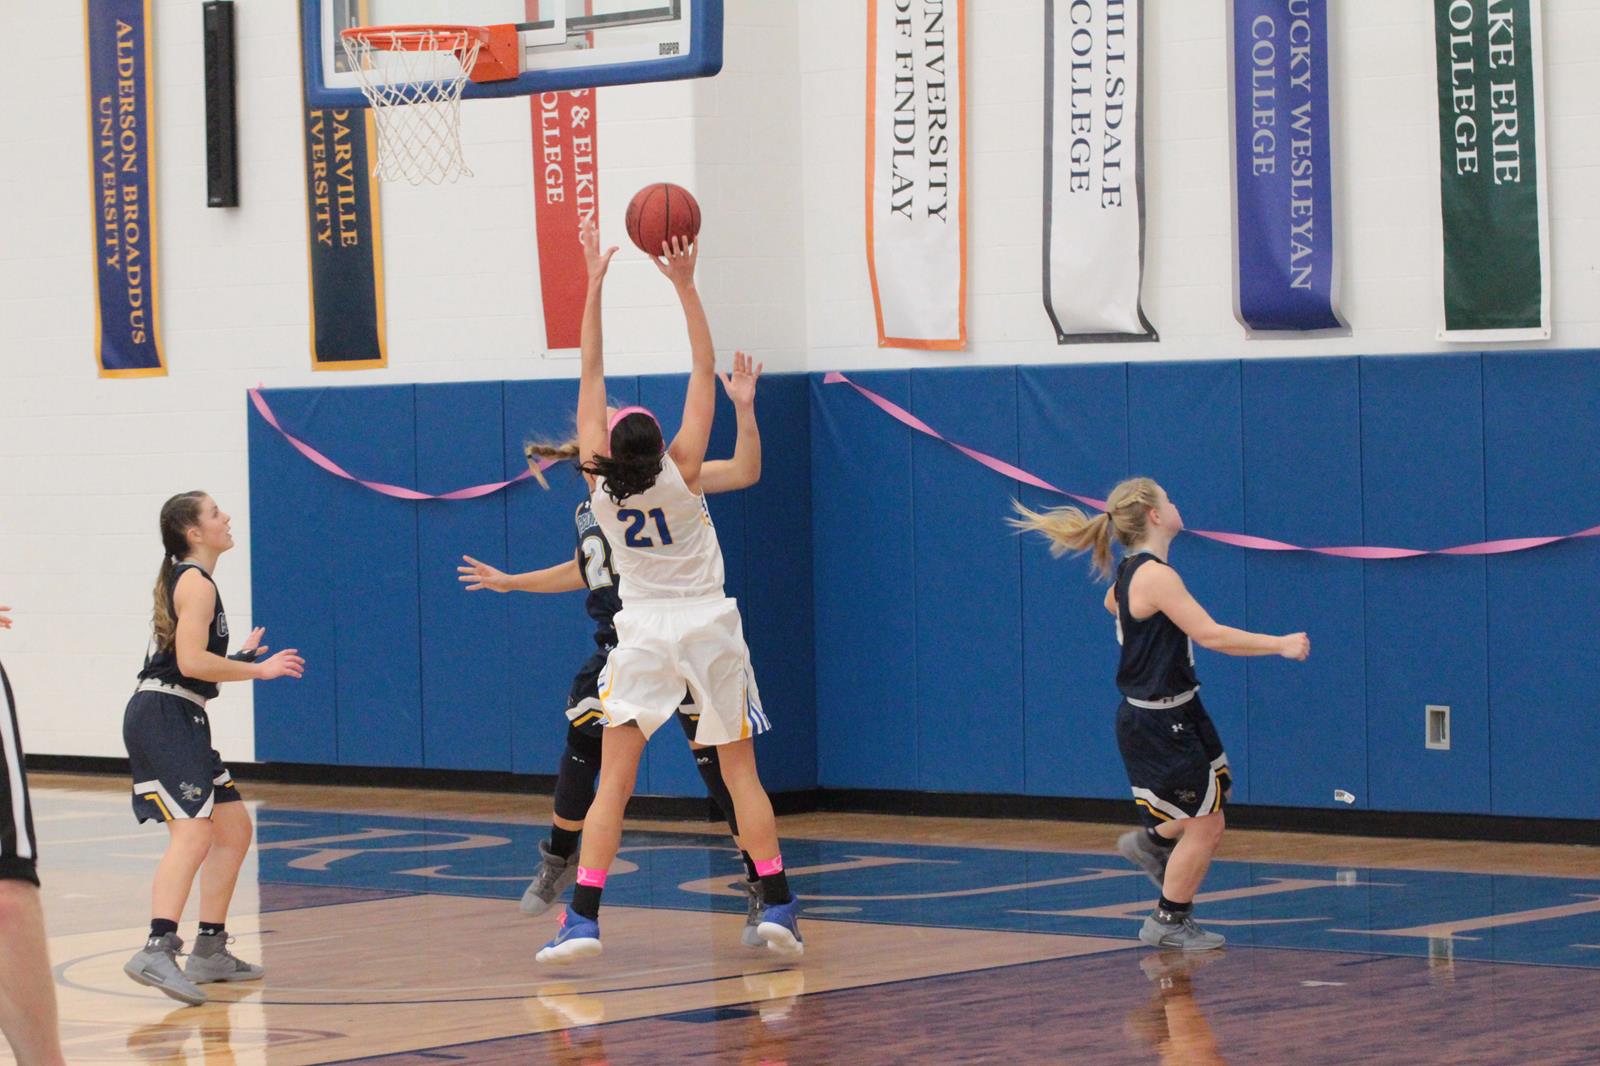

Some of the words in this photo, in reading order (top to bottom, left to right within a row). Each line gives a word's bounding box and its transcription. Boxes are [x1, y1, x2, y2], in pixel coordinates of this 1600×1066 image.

[115, 19, 138, 173] ALDERSON
[540, 92, 565, 205] OLLEGE
[570, 105, 591, 129] &
[890, 49, 916, 221] FINDLAY
[922, 0, 948, 224] NIVERSITY
[1070, 0, 1093, 193] COLLEGE
[1251, 15, 1276, 177] COLLEGE
[1449, 0, 1479, 176] OLLEGE
[1490, 79, 1521, 185] ERIE
[100, 96, 121, 271] UNIVERSITY
[123, 184, 146, 345] BROADDUS
[1290, 101, 1313, 290] WESLEYAN
[616, 507, 674, 548] 21
